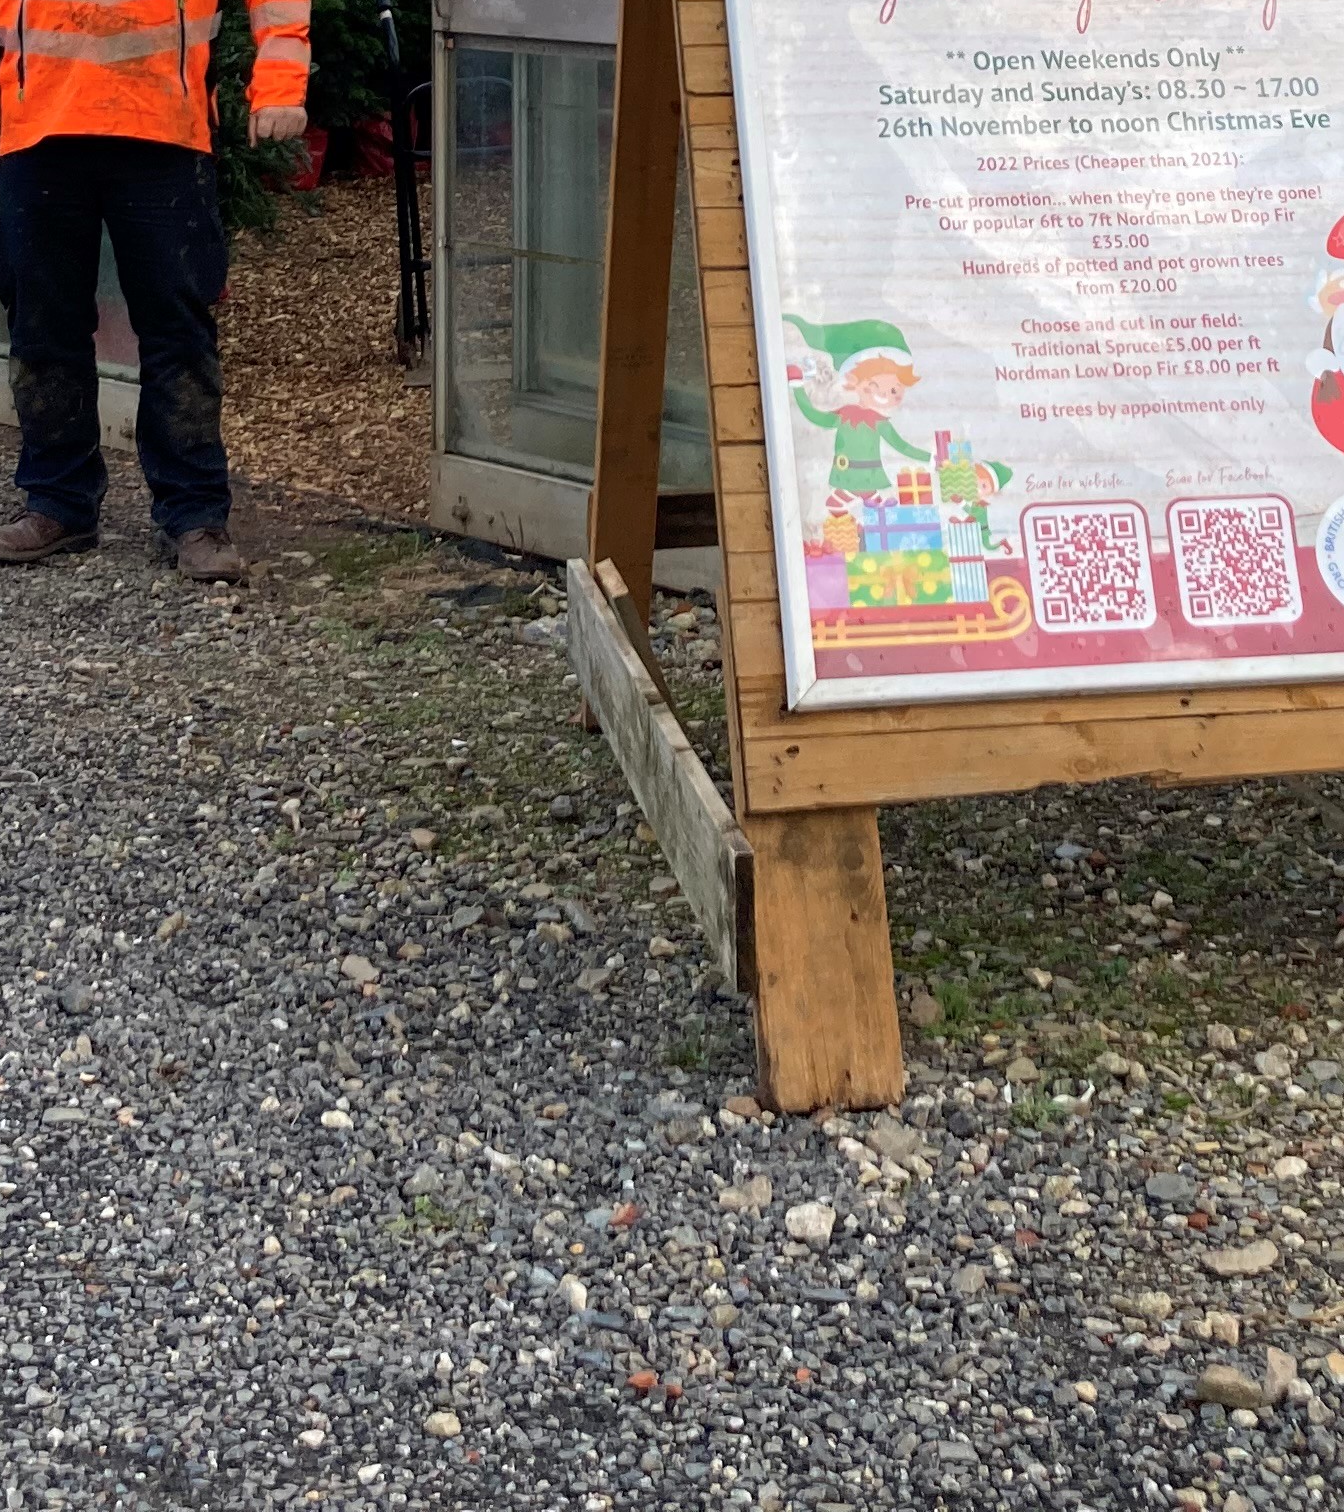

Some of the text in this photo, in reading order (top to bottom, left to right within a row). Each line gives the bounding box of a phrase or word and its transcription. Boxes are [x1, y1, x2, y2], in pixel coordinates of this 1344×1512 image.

[973, 50, 1035, 76] Open
[1041, 47, 1160, 70] Weekends
[1167, 46, 1221, 72] Only
[879, 85, 983, 108] Saturday
[991, 83, 1034, 104] and
[1042, 80, 1152, 106] Sunday's:
[1157, 78, 1226, 101] 08.30
[1255, 77, 1320, 98] 17.00
[876, 110, 1331, 139] 26th November to noon Christmas Eve
[976, 151, 1245, 172] 2022 Prices (Cheaper than 2021):
[905, 194, 963, 210] Pre-cut
[1070, 190, 1113, 205] when
[1117, 188, 1171, 207] they're
[1176, 191, 1217, 206] gone
[1220, 186, 1274, 204] they're
[1278, 186, 1323, 204] gone!
[939, 208, 1295, 233] Our popular 6ft to 7ft Nordman Low Drop Fir
[1092, 234, 1150, 250] £35.00
[963, 253, 1285, 275] Hundreds of potted and pot grown trees
[1076, 278, 1178, 295] from £20.00
[1021, 313, 1244, 334] Choose and cut in our field:
[1011, 336, 1261, 357] Traditional Spruce £5.00 per ft
[995, 358, 1280, 381] Nordman Low Drop Fir £8.00 per ft
[1020, 396, 1265, 421] Big trees by appointment only
